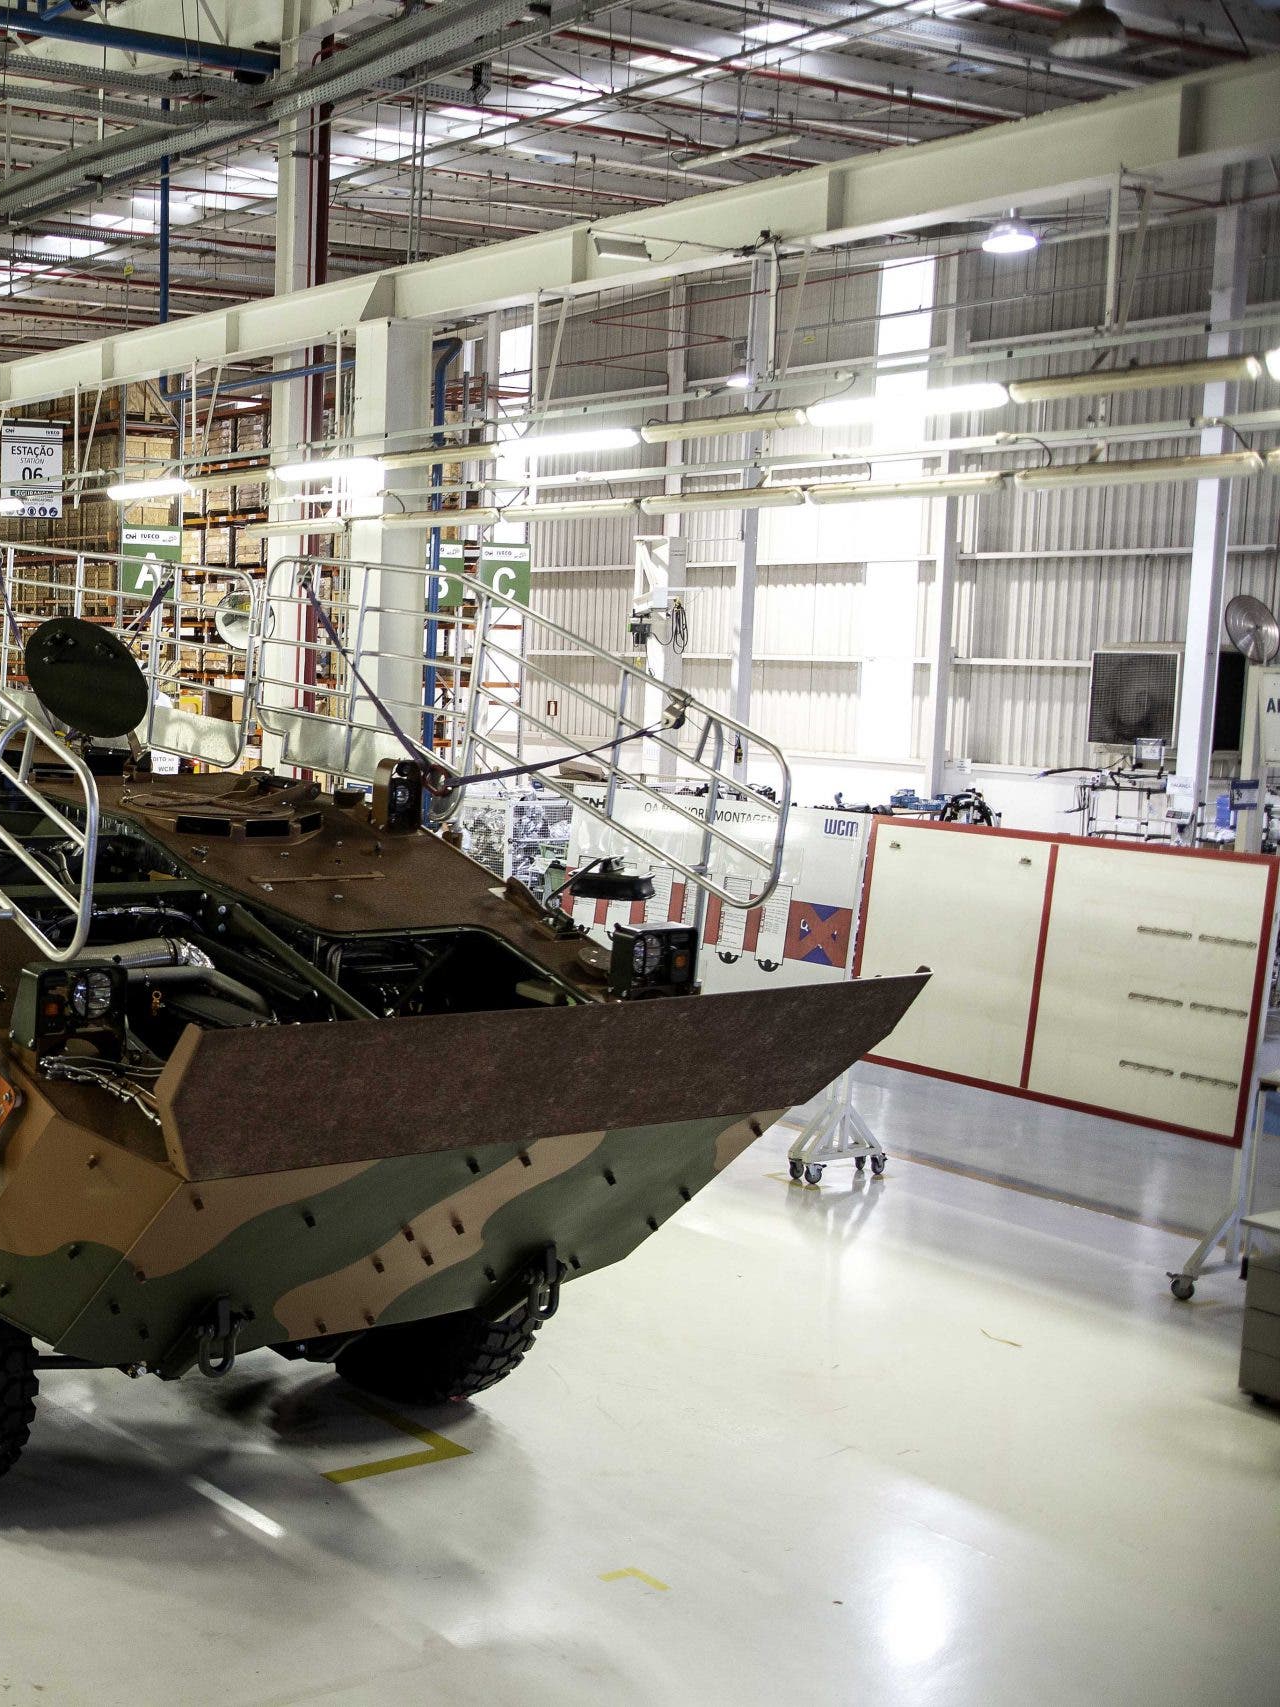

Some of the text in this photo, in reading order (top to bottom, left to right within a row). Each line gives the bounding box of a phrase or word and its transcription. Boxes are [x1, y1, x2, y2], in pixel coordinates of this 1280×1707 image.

[11, 445, 54, 458] ESTAÇÃO
[22, 467, 43, 481] 06
[135, 553, 166, 590] A
[492, 567, 516, 601] C
[824, 819, 859, 837] WCM
